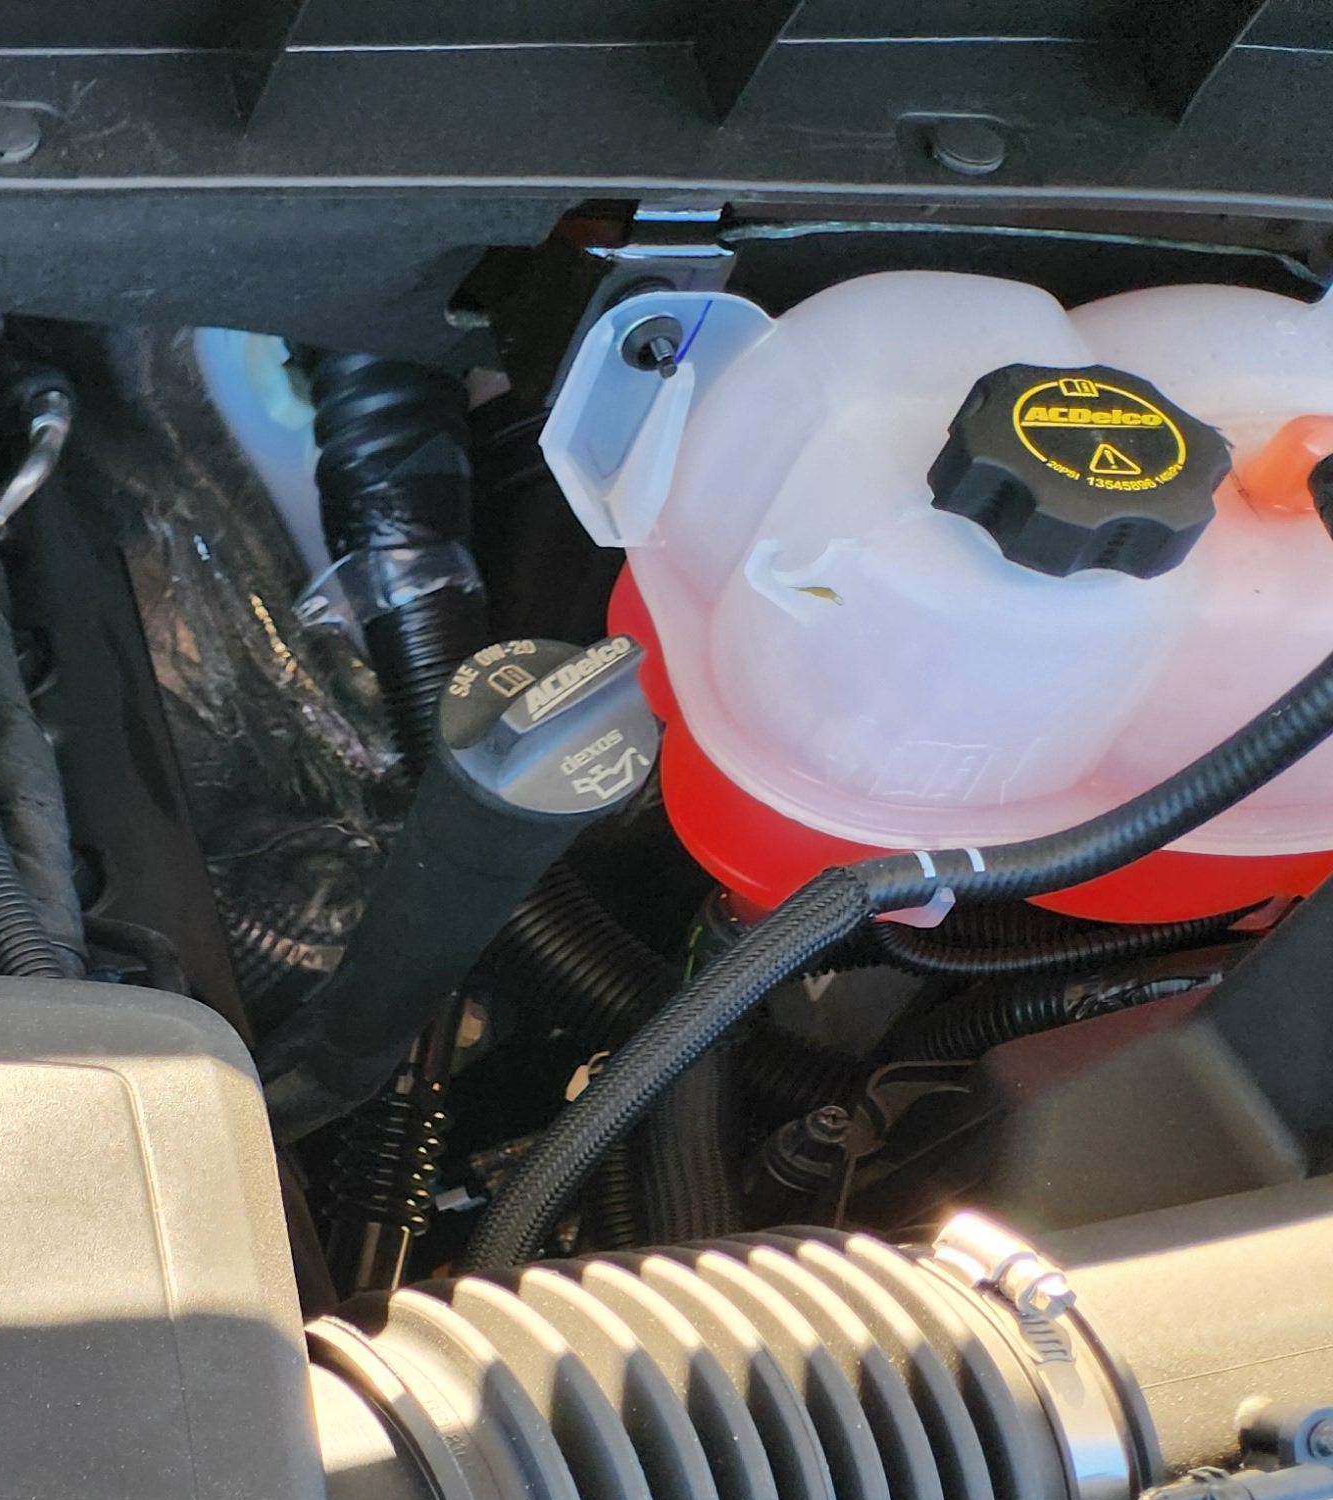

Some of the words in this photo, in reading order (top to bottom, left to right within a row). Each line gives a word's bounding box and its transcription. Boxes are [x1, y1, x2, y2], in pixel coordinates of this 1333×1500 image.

[1024, 406, 1164, 427] ACDelco
[1046, 460, 1081, 480] 20PSI
[448, 664, 480, 698] SAE
[473, 639, 537, 667] 0W-20
[523, 636, 632, 716] ACDelco
[560, 728, 624, 776] dexos
